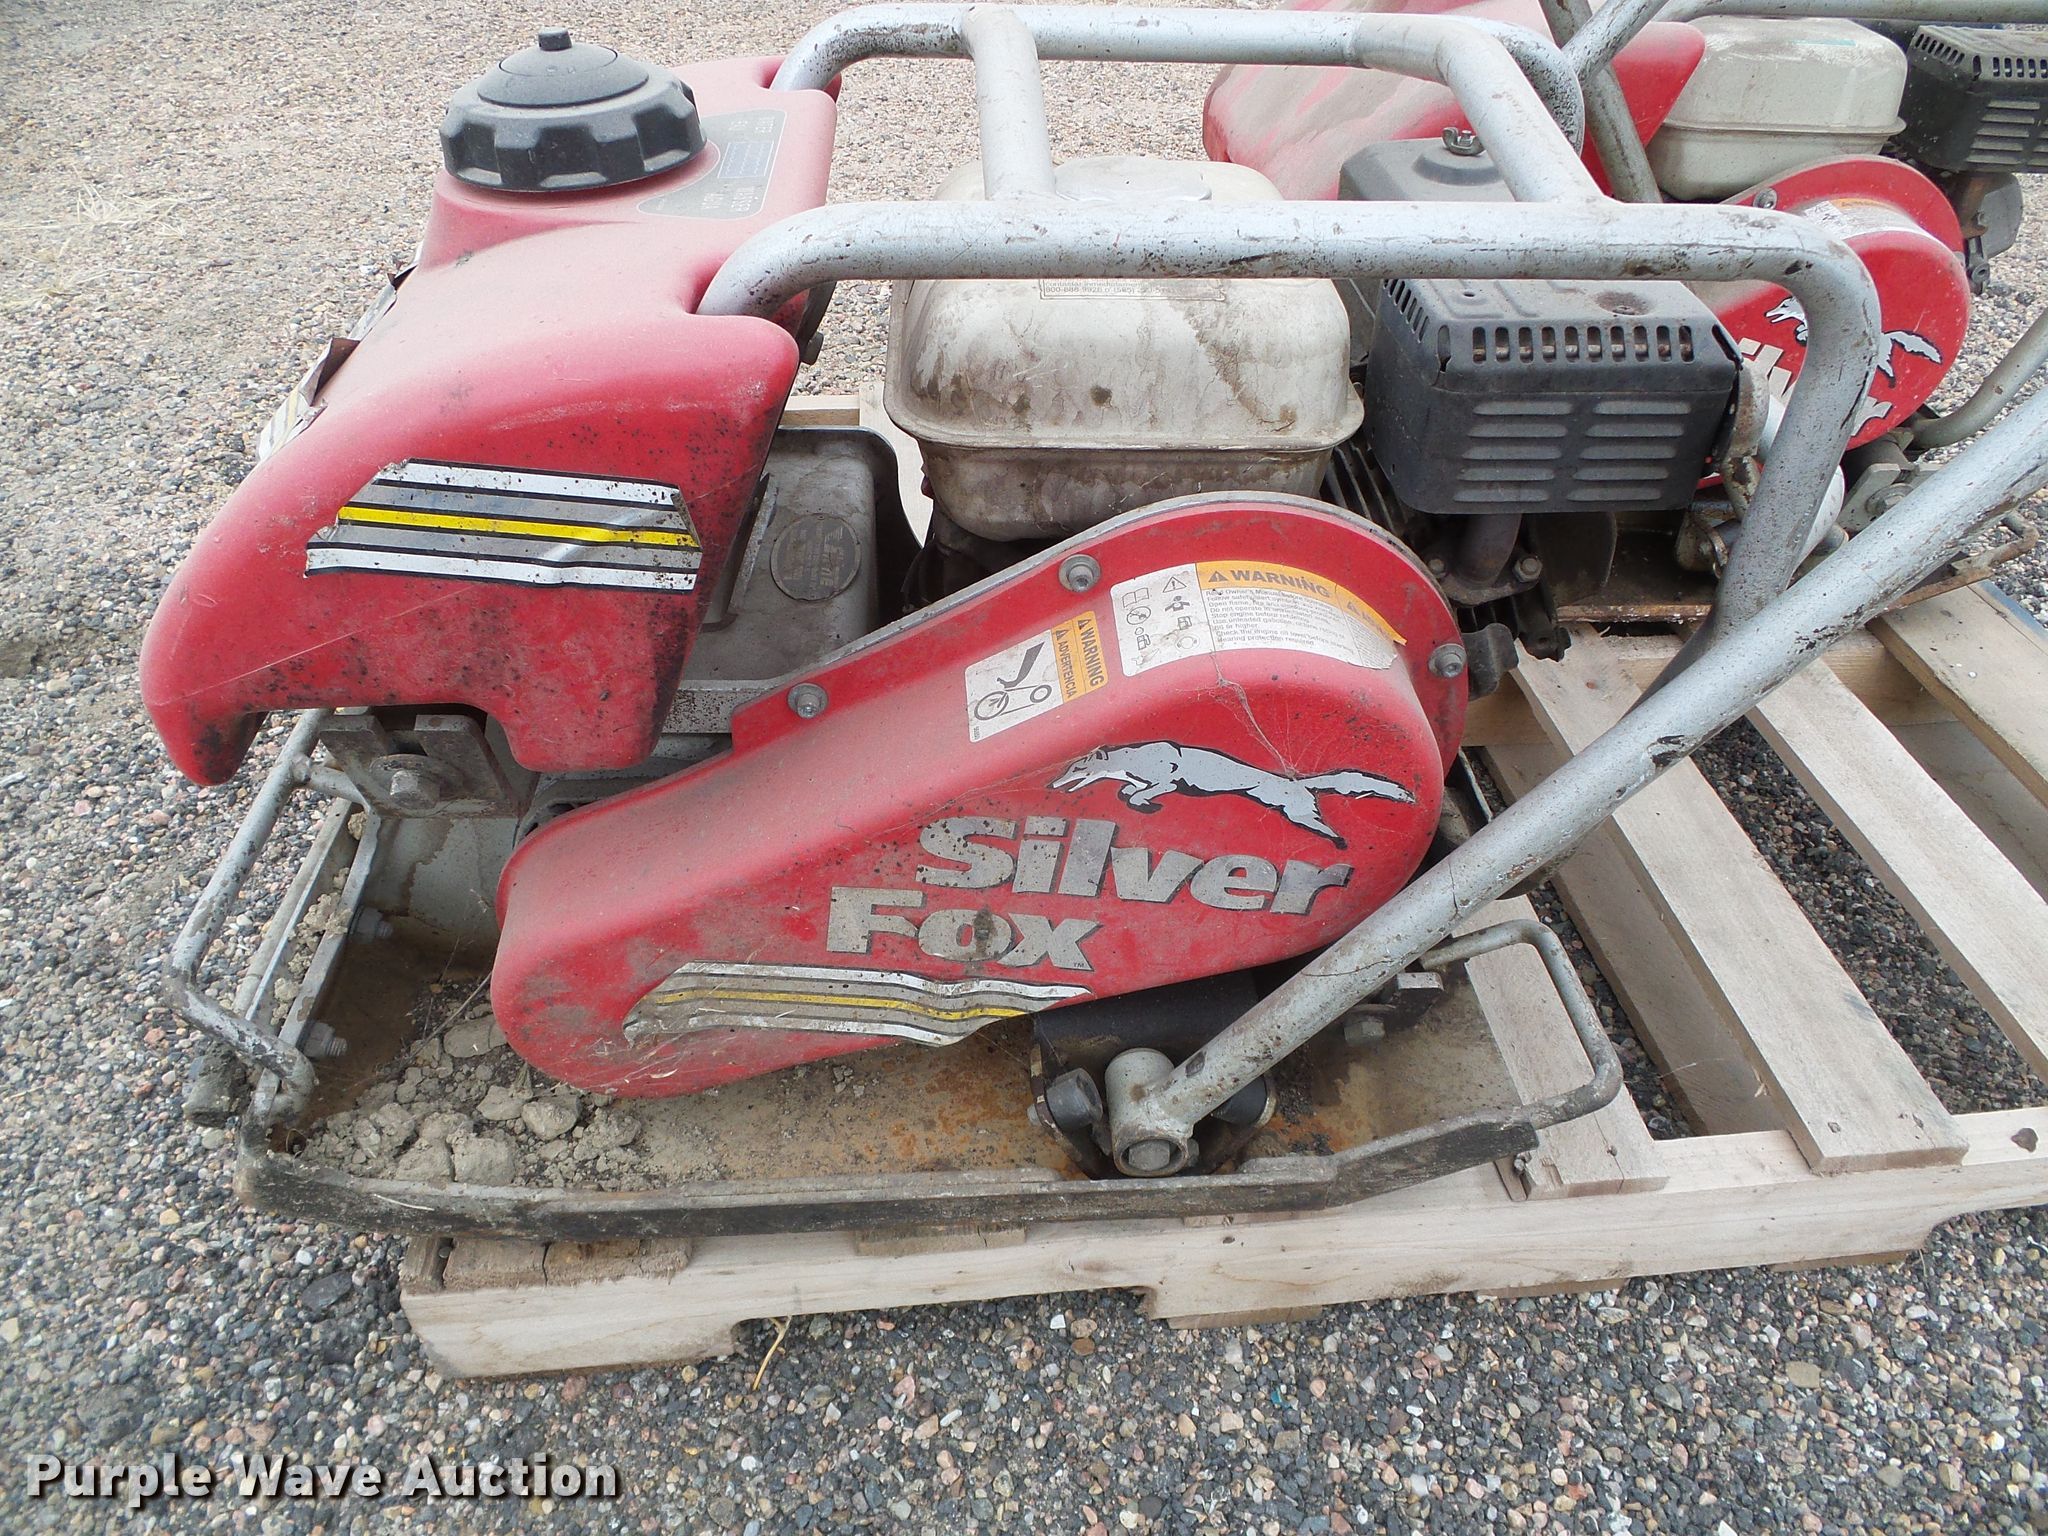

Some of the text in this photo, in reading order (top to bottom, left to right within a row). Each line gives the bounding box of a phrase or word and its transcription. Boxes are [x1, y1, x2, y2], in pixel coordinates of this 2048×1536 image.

[1230, 570, 1330, 598] WARNING
[1058, 641, 1077, 699] ADVERTENCIA
[1081, 627, 1104, 686] WARNING
[915, 816, 1354, 914] Silver
[826, 887, 1101, 971] Fox
